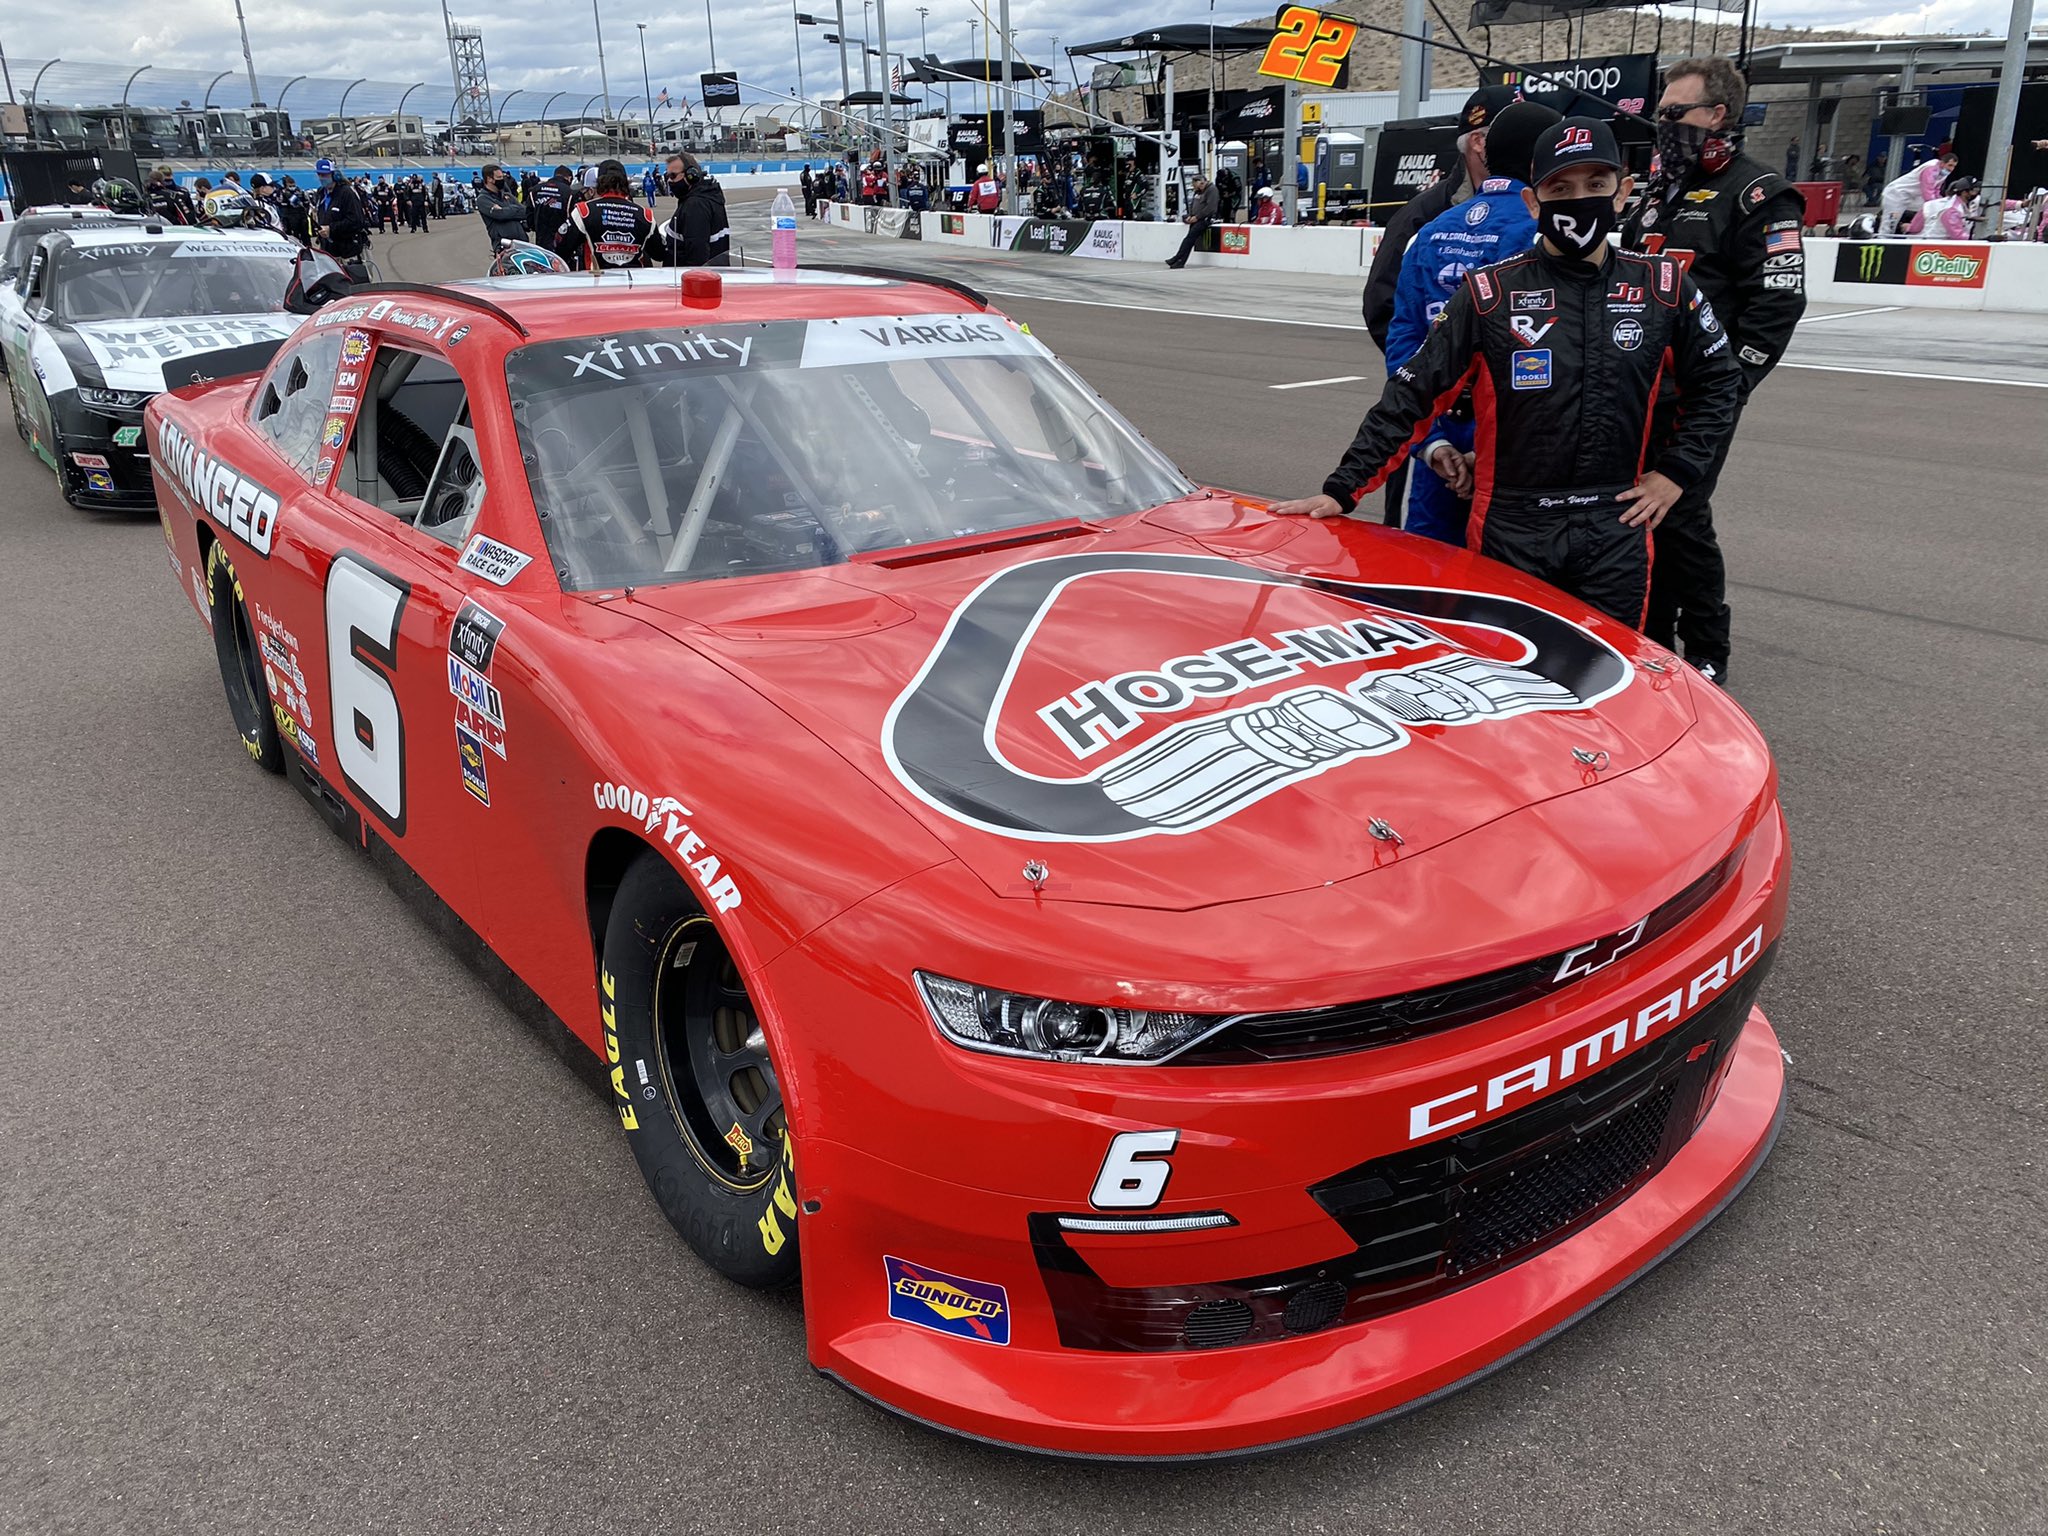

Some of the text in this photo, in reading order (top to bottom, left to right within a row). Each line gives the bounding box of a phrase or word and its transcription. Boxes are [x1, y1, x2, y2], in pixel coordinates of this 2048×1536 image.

[1258, 5, 1358, 87] 22
[1524, 64, 1621, 96] carshop
[937, 139, 947, 149] 16
[1398, 154, 1437, 170] KAULIG
[1394, 170, 1432, 185] RACING
[951, 191, 965, 201] 16
[71, 222, 118, 231] xfinity
[1049, 225, 1068, 241] Filter
[1094, 229, 1113, 240] KAULIG
[1551, 212, 1599, 248] RV
[78, 244, 157, 260] xfinity
[186, 242, 299, 254] WEATHERMAN
[1915, 250, 1983, 278] O'Reilly
[1764, 273, 1803, 289] KSDT
[1518, 296, 1549, 307] xfinity
[89, 319, 272, 344] WEICKS
[858, 323, 1006, 347] VARGAS
[1613, 328, 1643, 341] NEXT
[106, 328, 277, 362] MEDIA
[563, 331, 754, 381] xfinity
[1515, 373, 1549, 382] ROOKIE
[113, 426, 141, 447] 47
[158, 416, 281, 558] ADVANCED
[1538, 494, 1599, 508] Ryan Vargas
[465, 554, 507, 579] RACE CAR
[482, 541, 520, 568] NASCAR
[473, 612, 491, 630] NASCAR
[457, 622, 489, 664] xfinity
[464, 648, 478, 666] SERIES
[325, 552, 406, 830] 6
[450, 658, 486, 709] Mobil
[1047, 617, 1442, 755] HOSE-MAN
[456, 699, 504, 748] ARP
[461, 746, 482, 768] SUNOCO
[463, 767, 486, 791] ROOKIE
[593, 781, 743, 914] GOODYEAR
[1409, 923, 1764, 1141] CAMARO
[601, 960, 640, 1131] EAGLE
[730, 1132, 749, 1152] AERO
[1090, 1129, 1180, 1210] 6
[899, 1278, 999, 1316] SUNOCO
